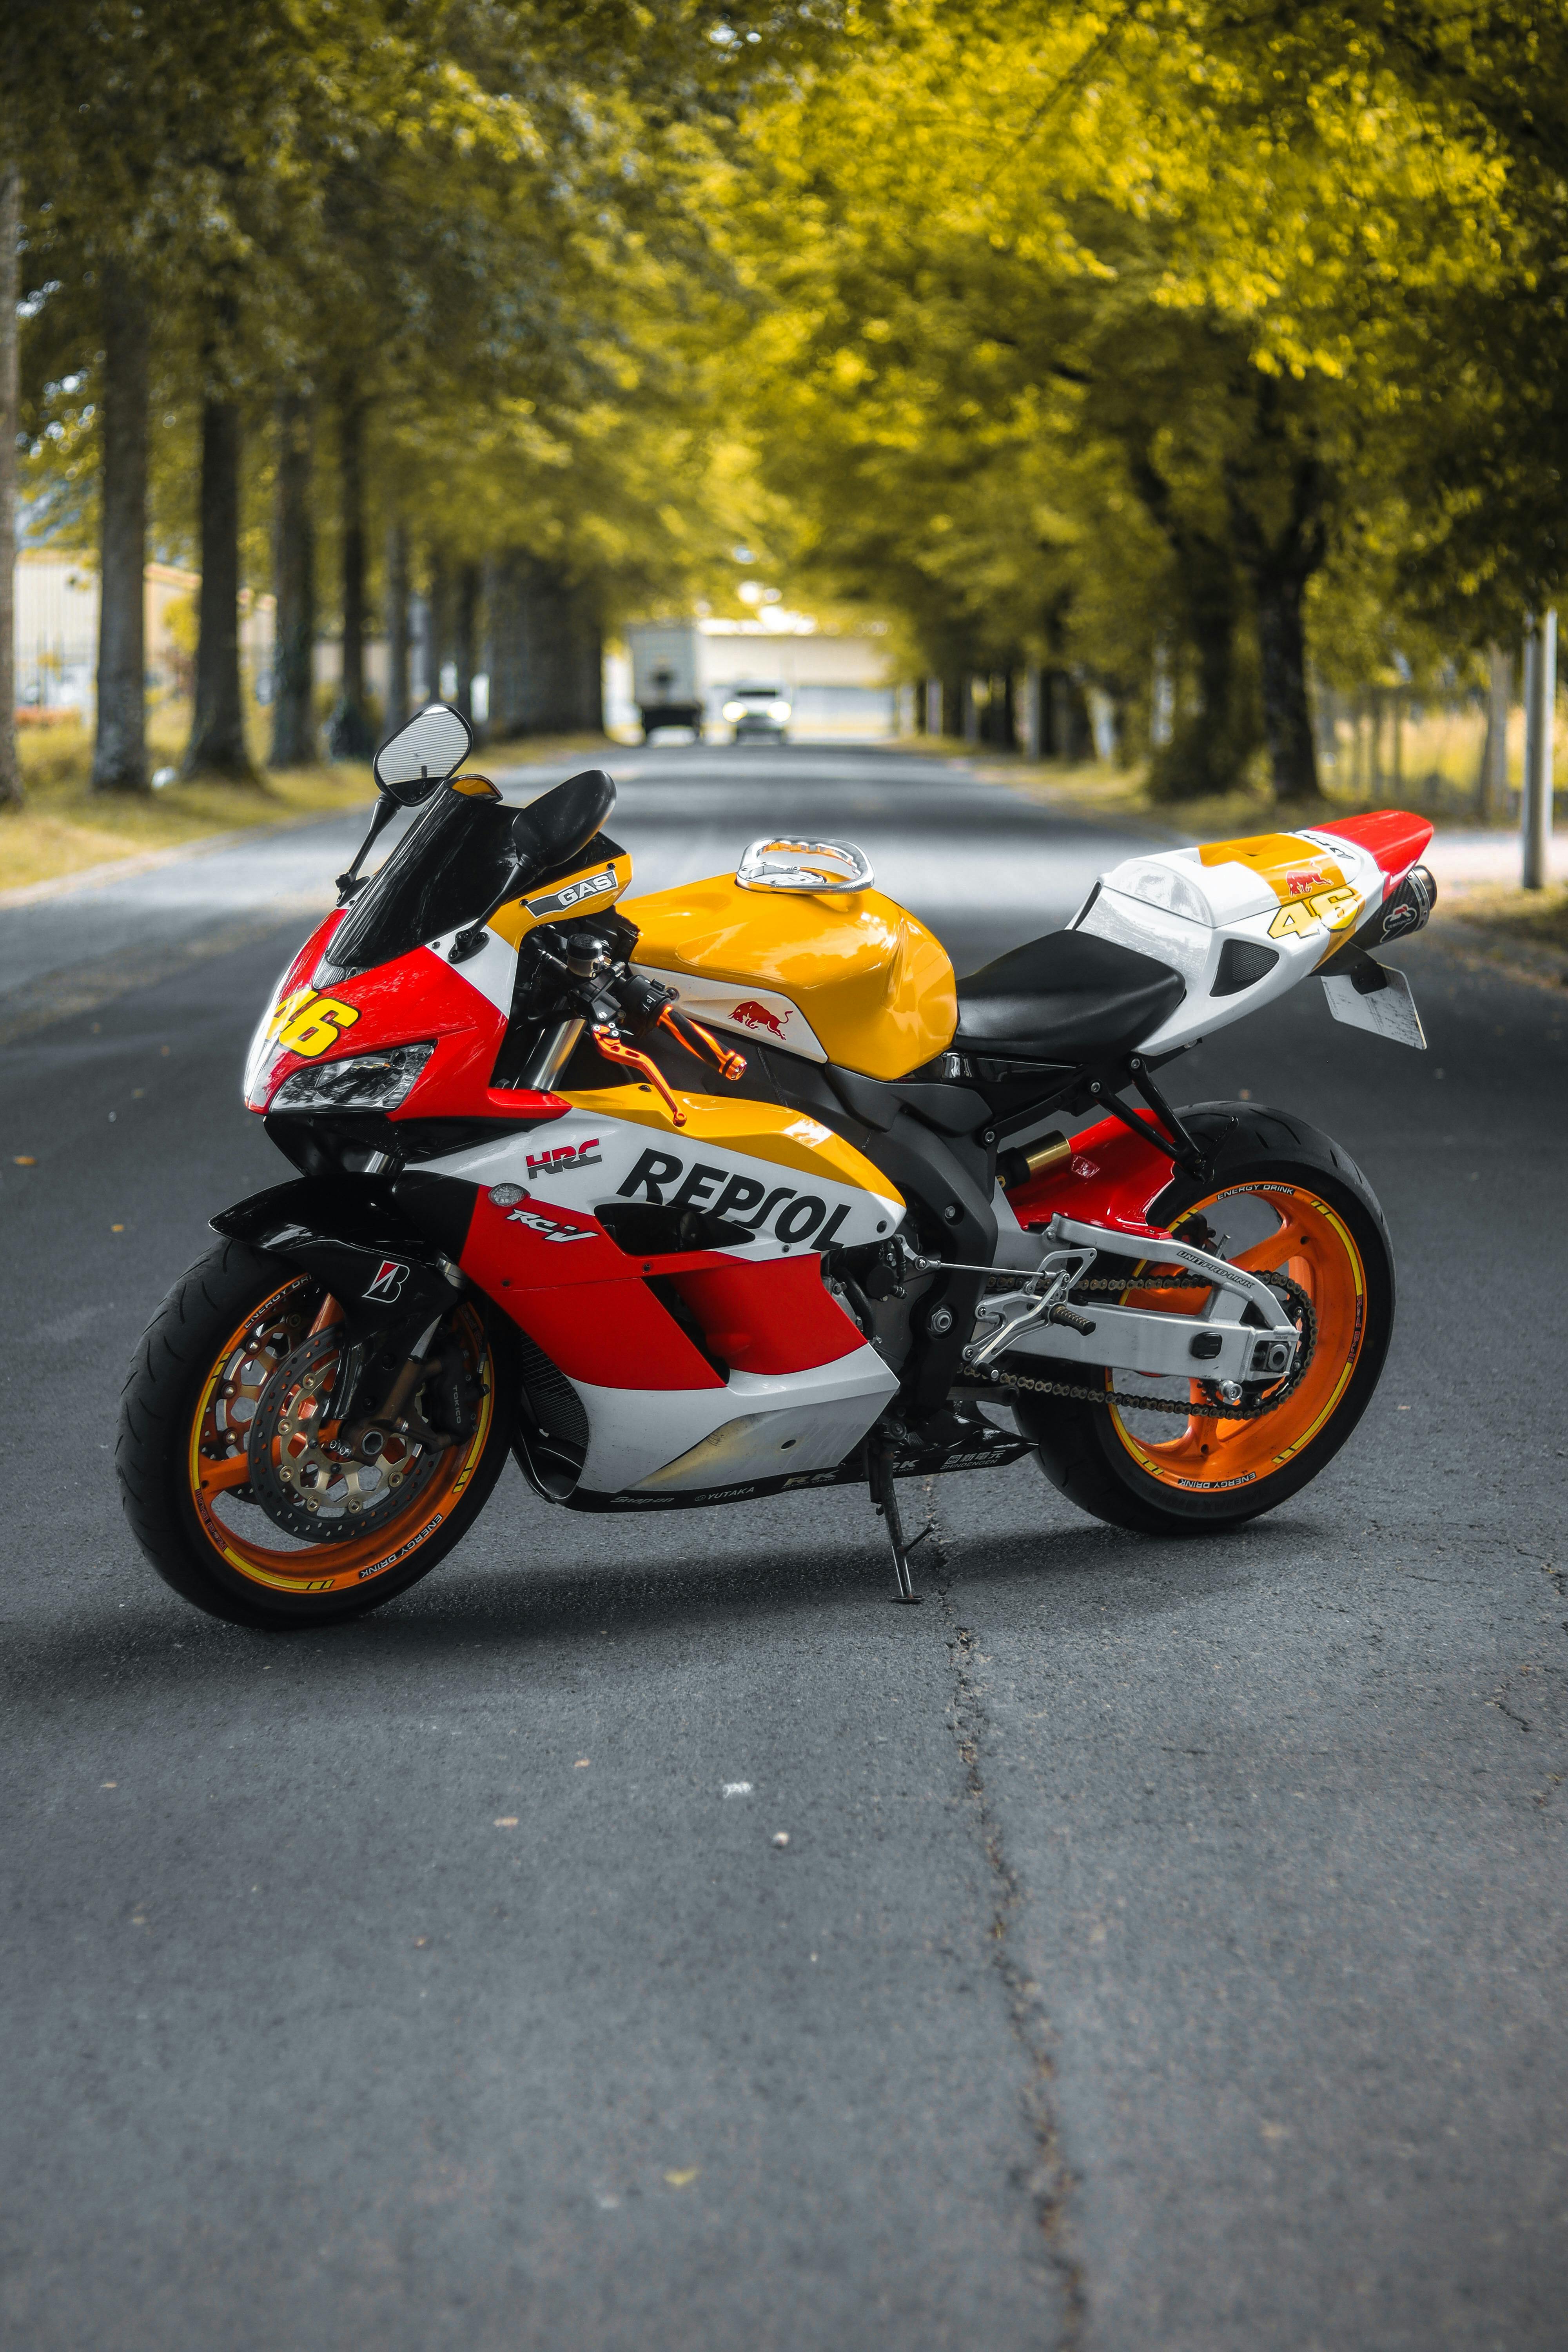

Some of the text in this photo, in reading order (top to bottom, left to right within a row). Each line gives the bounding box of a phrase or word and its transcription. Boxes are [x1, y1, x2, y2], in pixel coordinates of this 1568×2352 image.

[557, 874, 613, 906] GAS
[1267, 887, 1359, 939] 46
[267, 988, 361, 1058] 46
[525, 1138, 603, 1180] HRC
[616, 1148, 852, 1252] REPSOL
[1218, 1184, 1294, 1200] ENERGY DRINK
[1178, 1250, 1255, 1289] UNIT PRO-LINK
[245, 1274, 312, 1328] ENERGY DRI
[452, 1385, 462, 1424] TOKICO
[940, 1459, 998, 1470] SHINDENGEN
[1179, 1472, 1256, 1489] ENERGY DRINK
[707, 1486, 755, 1500] YUTAKA
[361, 1514, 443, 1579] ENERGY DRINK
